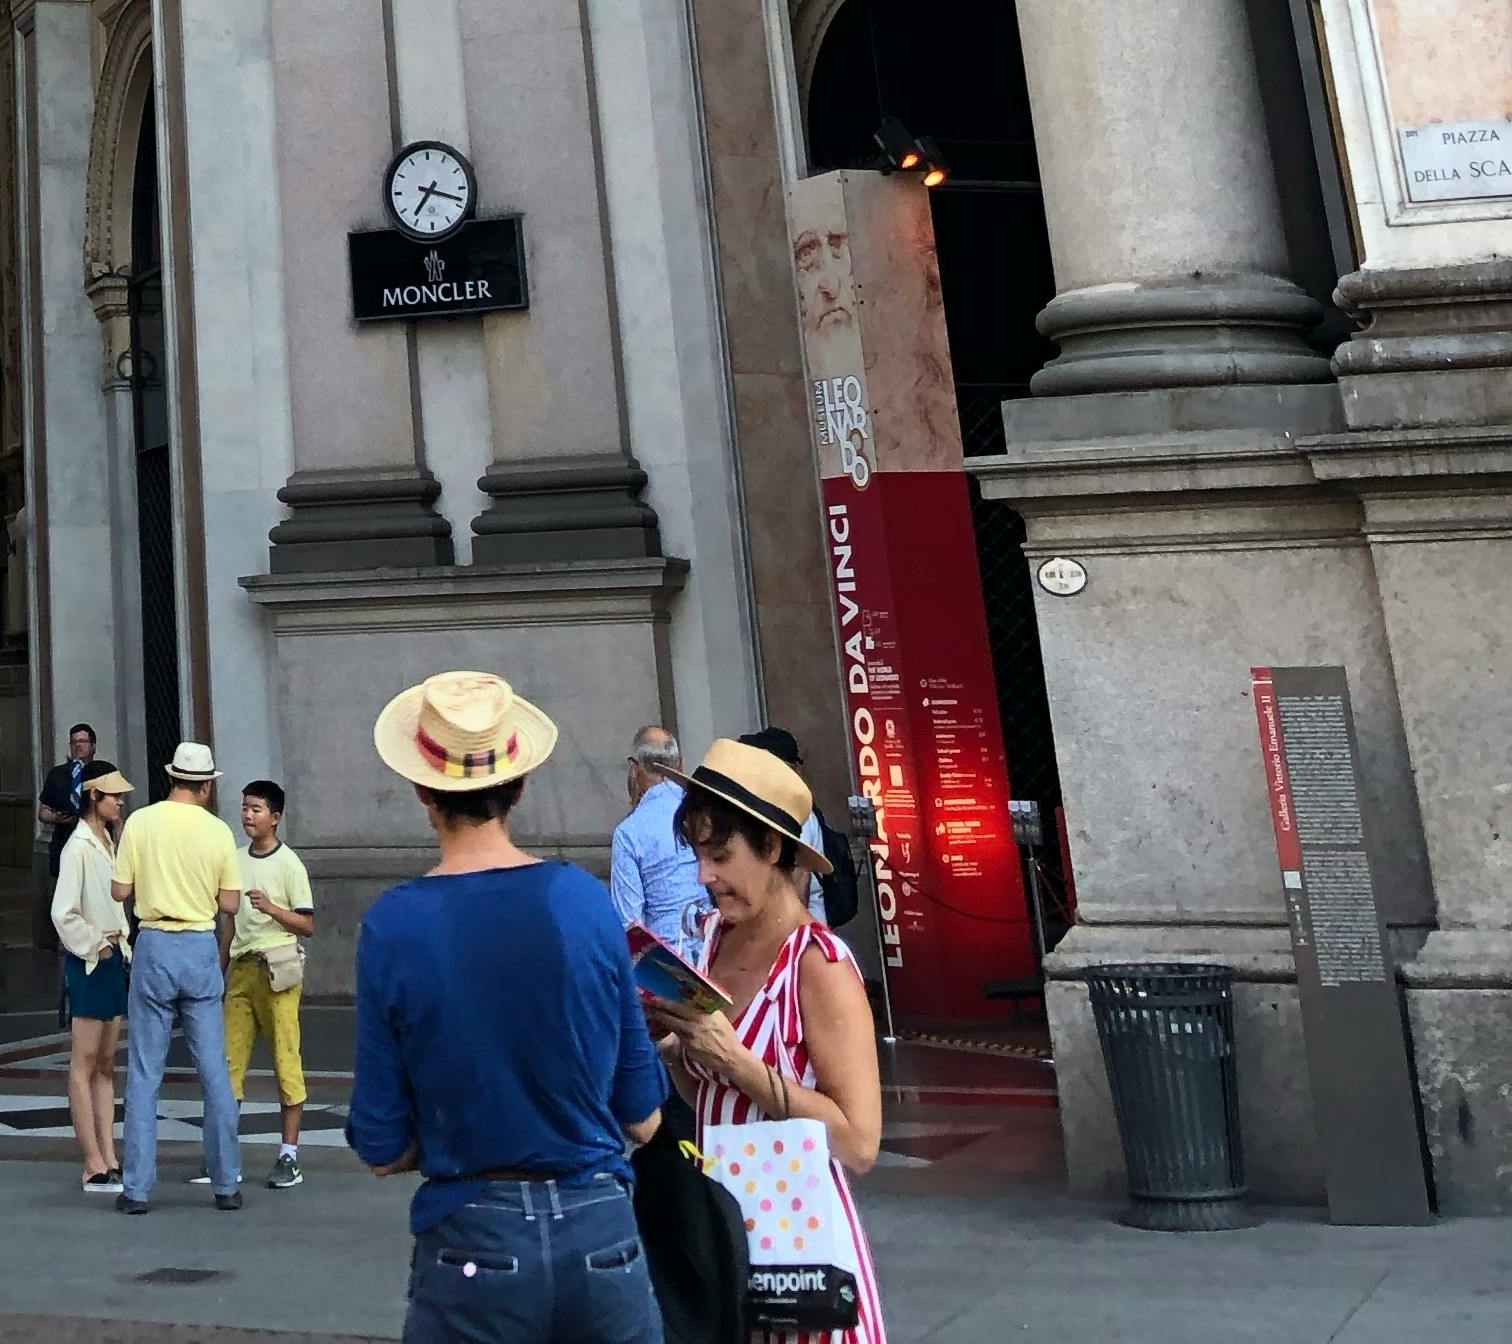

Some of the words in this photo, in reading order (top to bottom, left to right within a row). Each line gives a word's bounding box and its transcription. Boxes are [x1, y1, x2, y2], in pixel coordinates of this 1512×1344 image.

[1442, 129, 1500, 145] PIAZZA
[1414, 168, 1461, 183] DELLA
[1469, 160, 1512, 178] SCA
[382, 280, 493, 307] MONCLER
[814, 380, 828, 445] MUSEUM
[829, 504, 859, 626] VINCI
[845, 630, 869, 694] DA
[1263, 705, 1279, 752] Emanuele
[1272, 754, 1285, 792] Vittorio
[1278, 794, 1291, 831] Galleria
